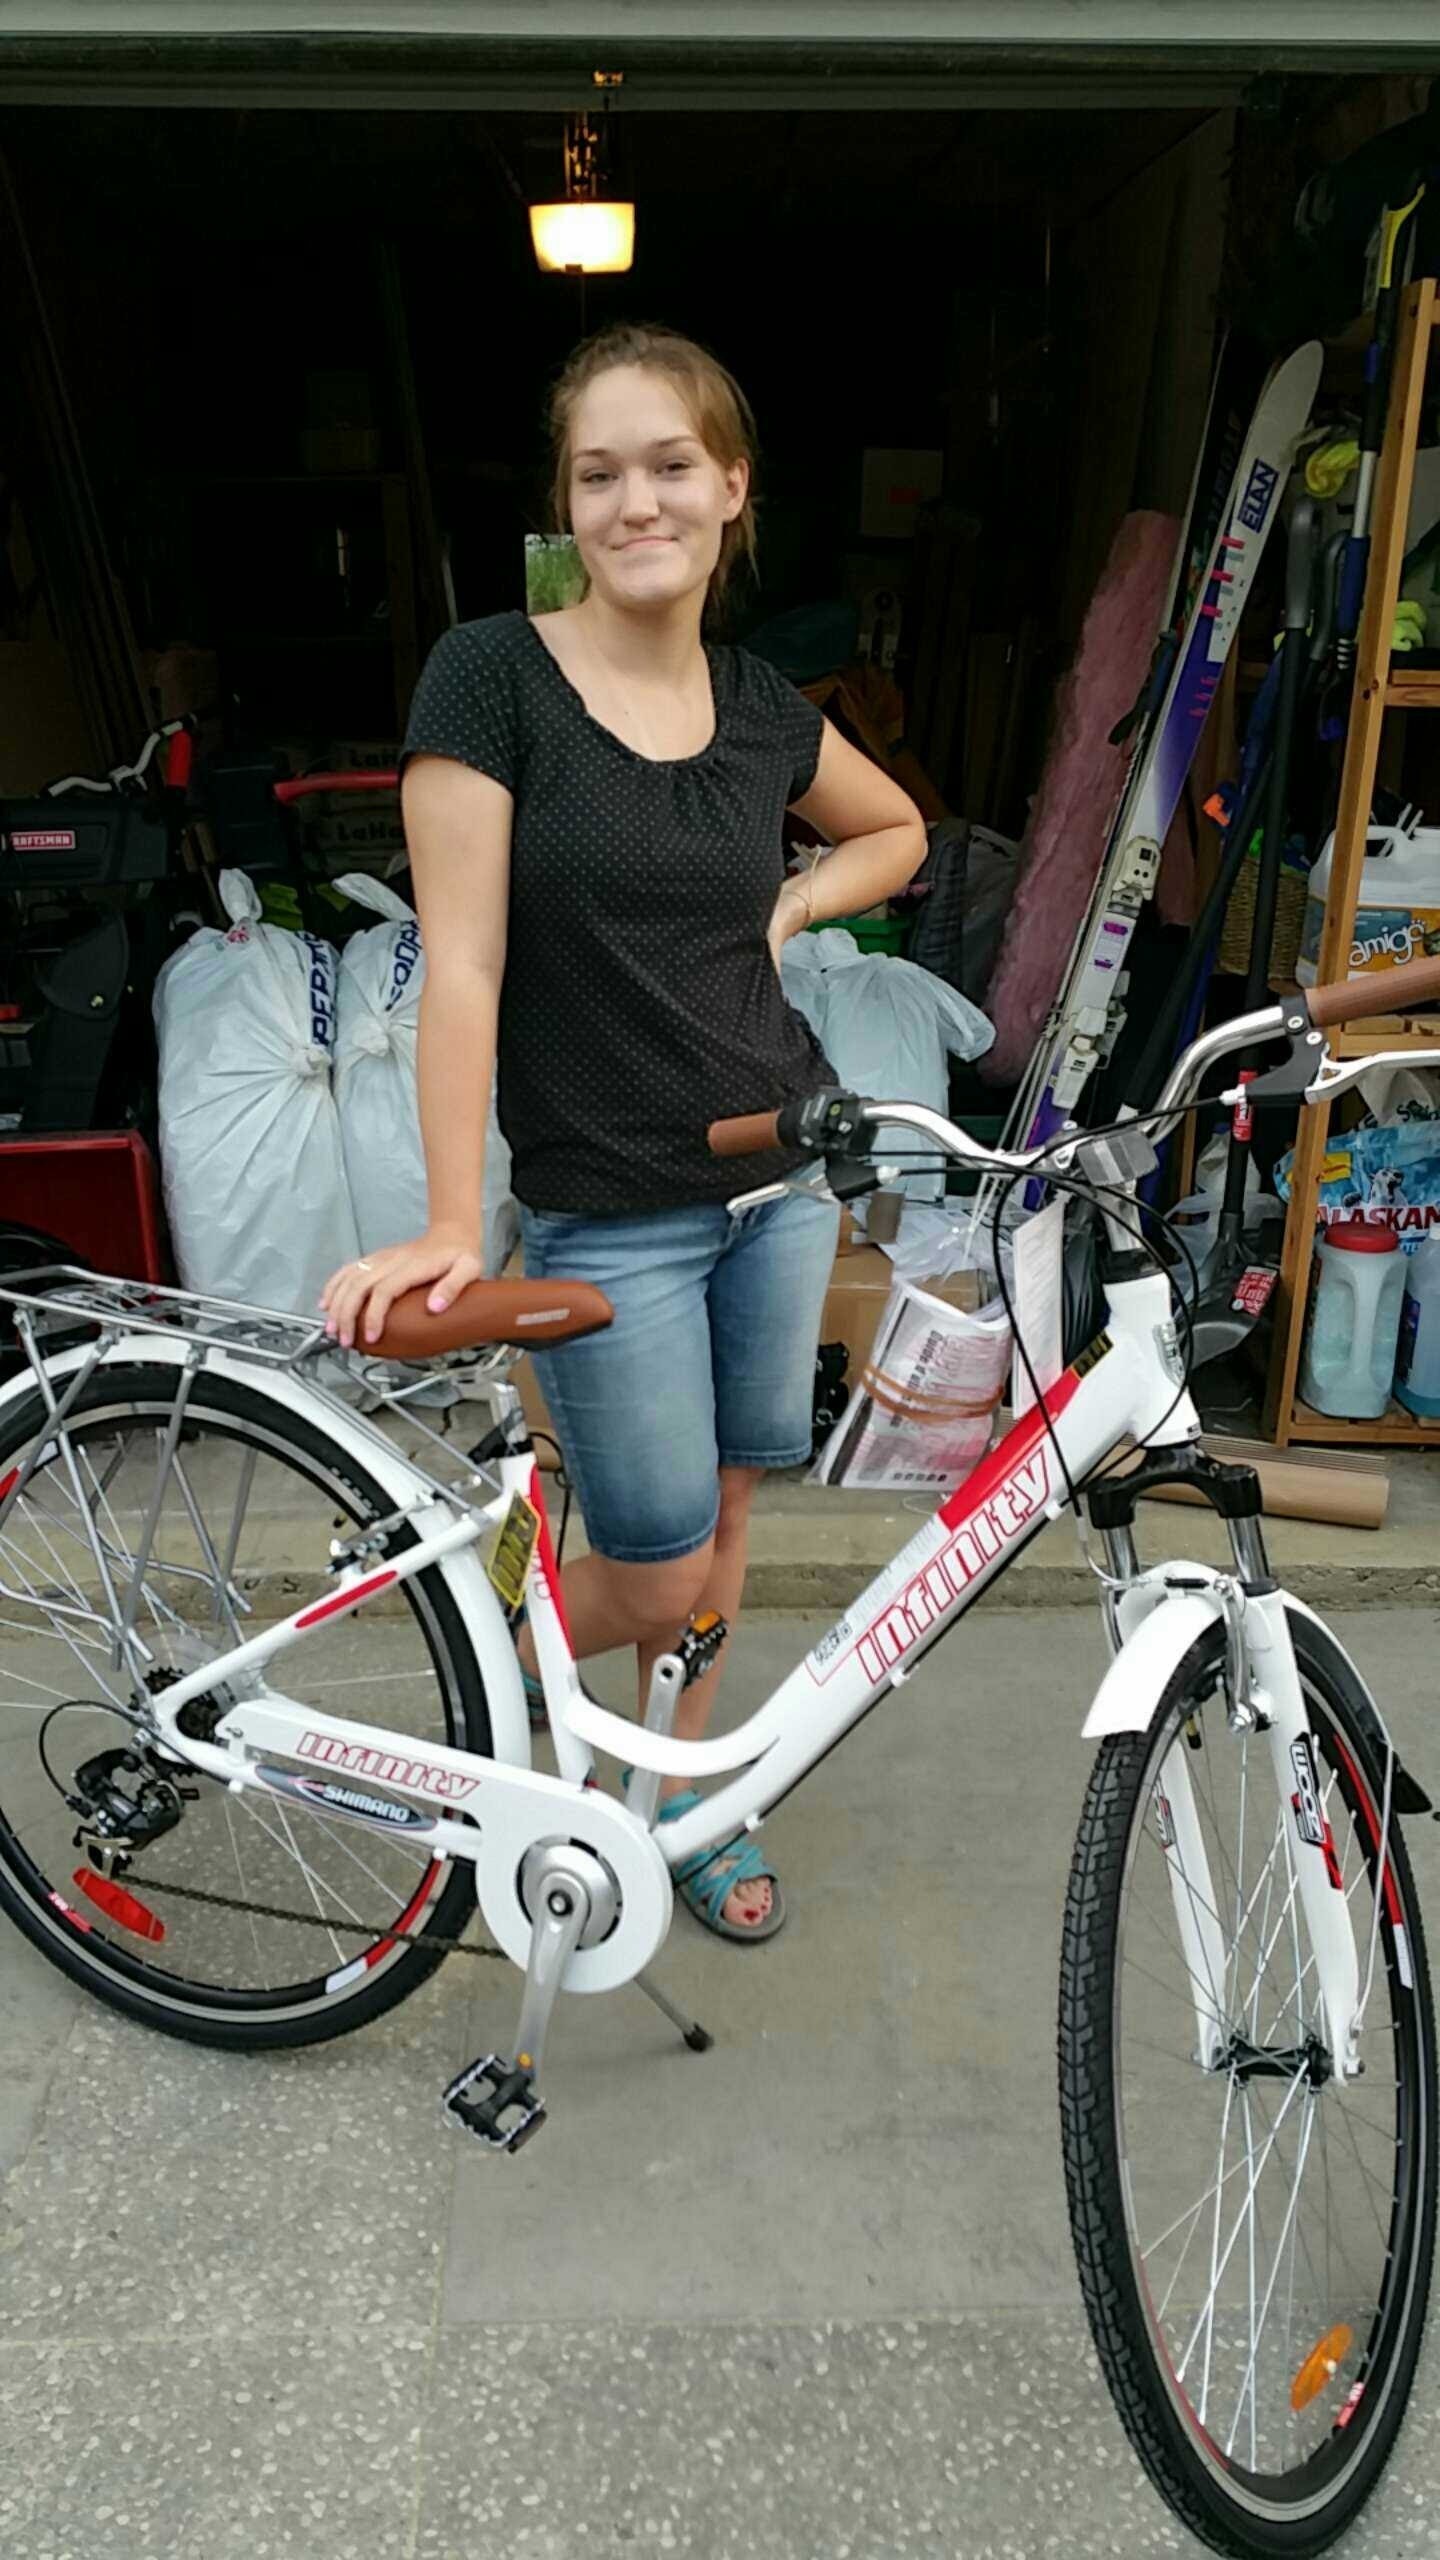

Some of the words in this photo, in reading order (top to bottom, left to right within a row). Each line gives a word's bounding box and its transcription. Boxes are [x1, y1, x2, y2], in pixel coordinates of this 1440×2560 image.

[1240, 459, 1279, 530] ELAN
[1349, 921, 1425, 966] amigo
[322, 1785, 410, 1824] SHIMANO
